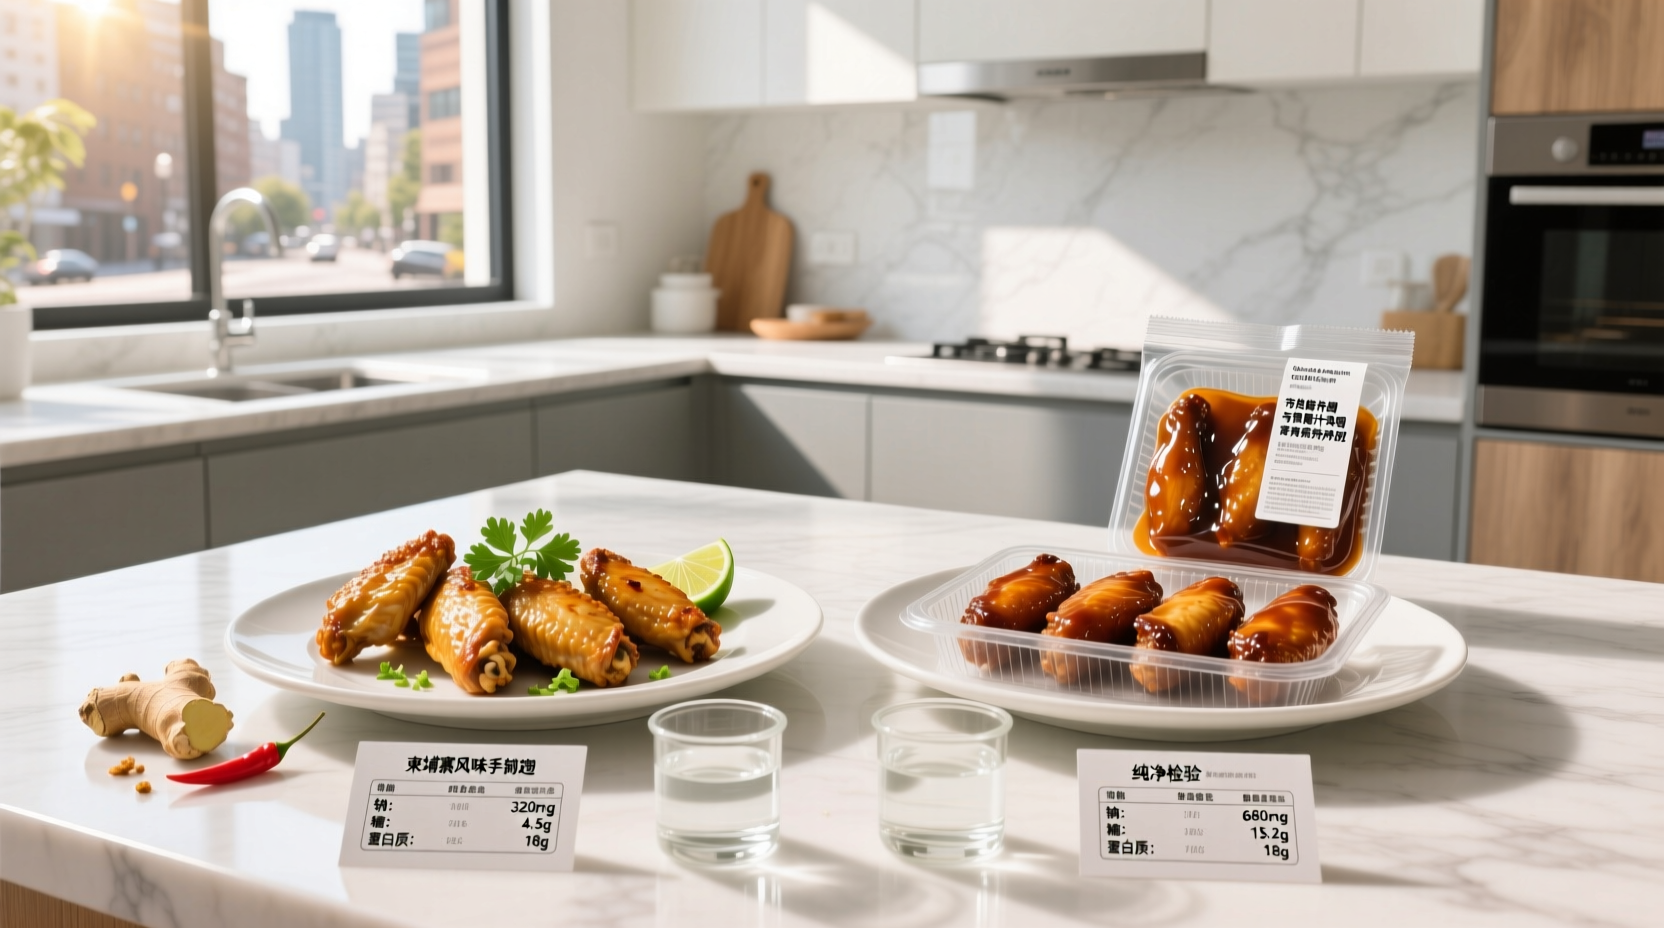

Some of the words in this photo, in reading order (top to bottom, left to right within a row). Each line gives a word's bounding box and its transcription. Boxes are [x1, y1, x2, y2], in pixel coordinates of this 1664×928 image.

[522, 816, 552, 833] 4.5g
[1243, 810, 1288, 826] 680mg
[1251, 827, 1289, 843] 15.2g
[1264, 845, 1290, 861] 18g
